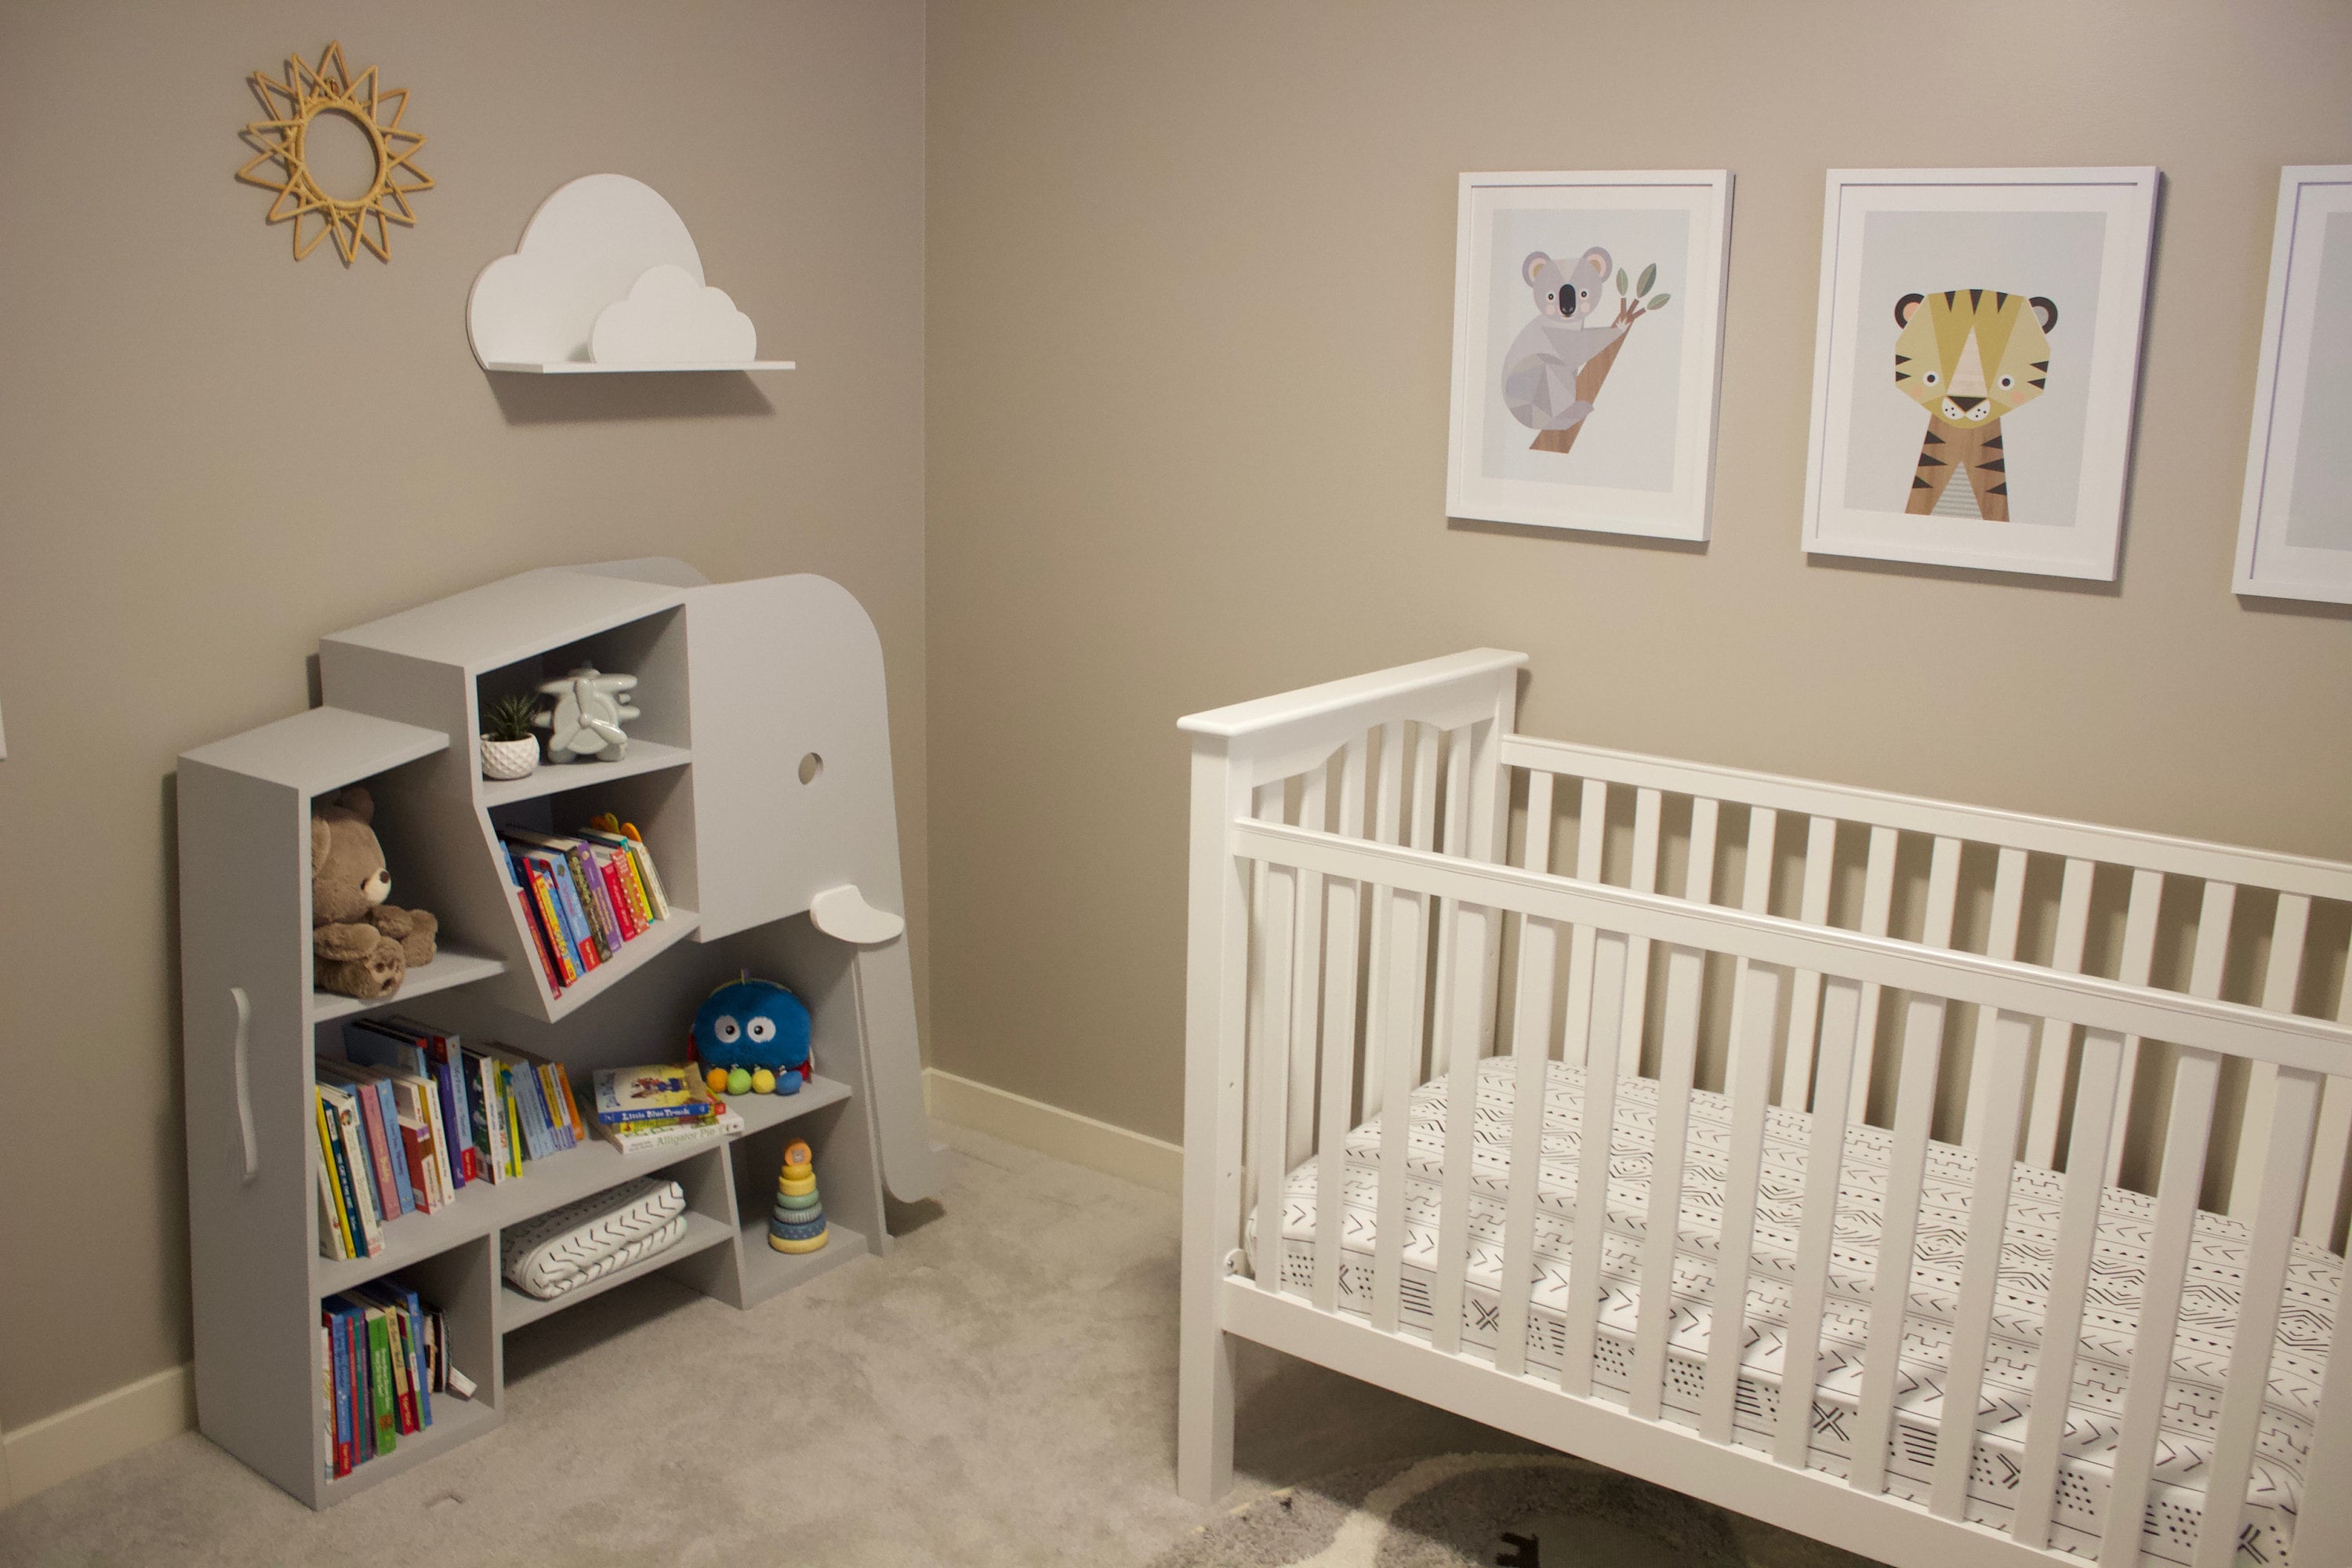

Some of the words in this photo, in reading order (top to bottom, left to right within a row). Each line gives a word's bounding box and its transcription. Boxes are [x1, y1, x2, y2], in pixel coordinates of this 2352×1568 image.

[622, 1112, 645, 1121] Little
[647, 1109, 664, 1119] Blue
[664, 1108, 690, 1117] Truck
[658, 1131, 697, 1145] Alligator
[700, 1127, 716, 1138] Pie
